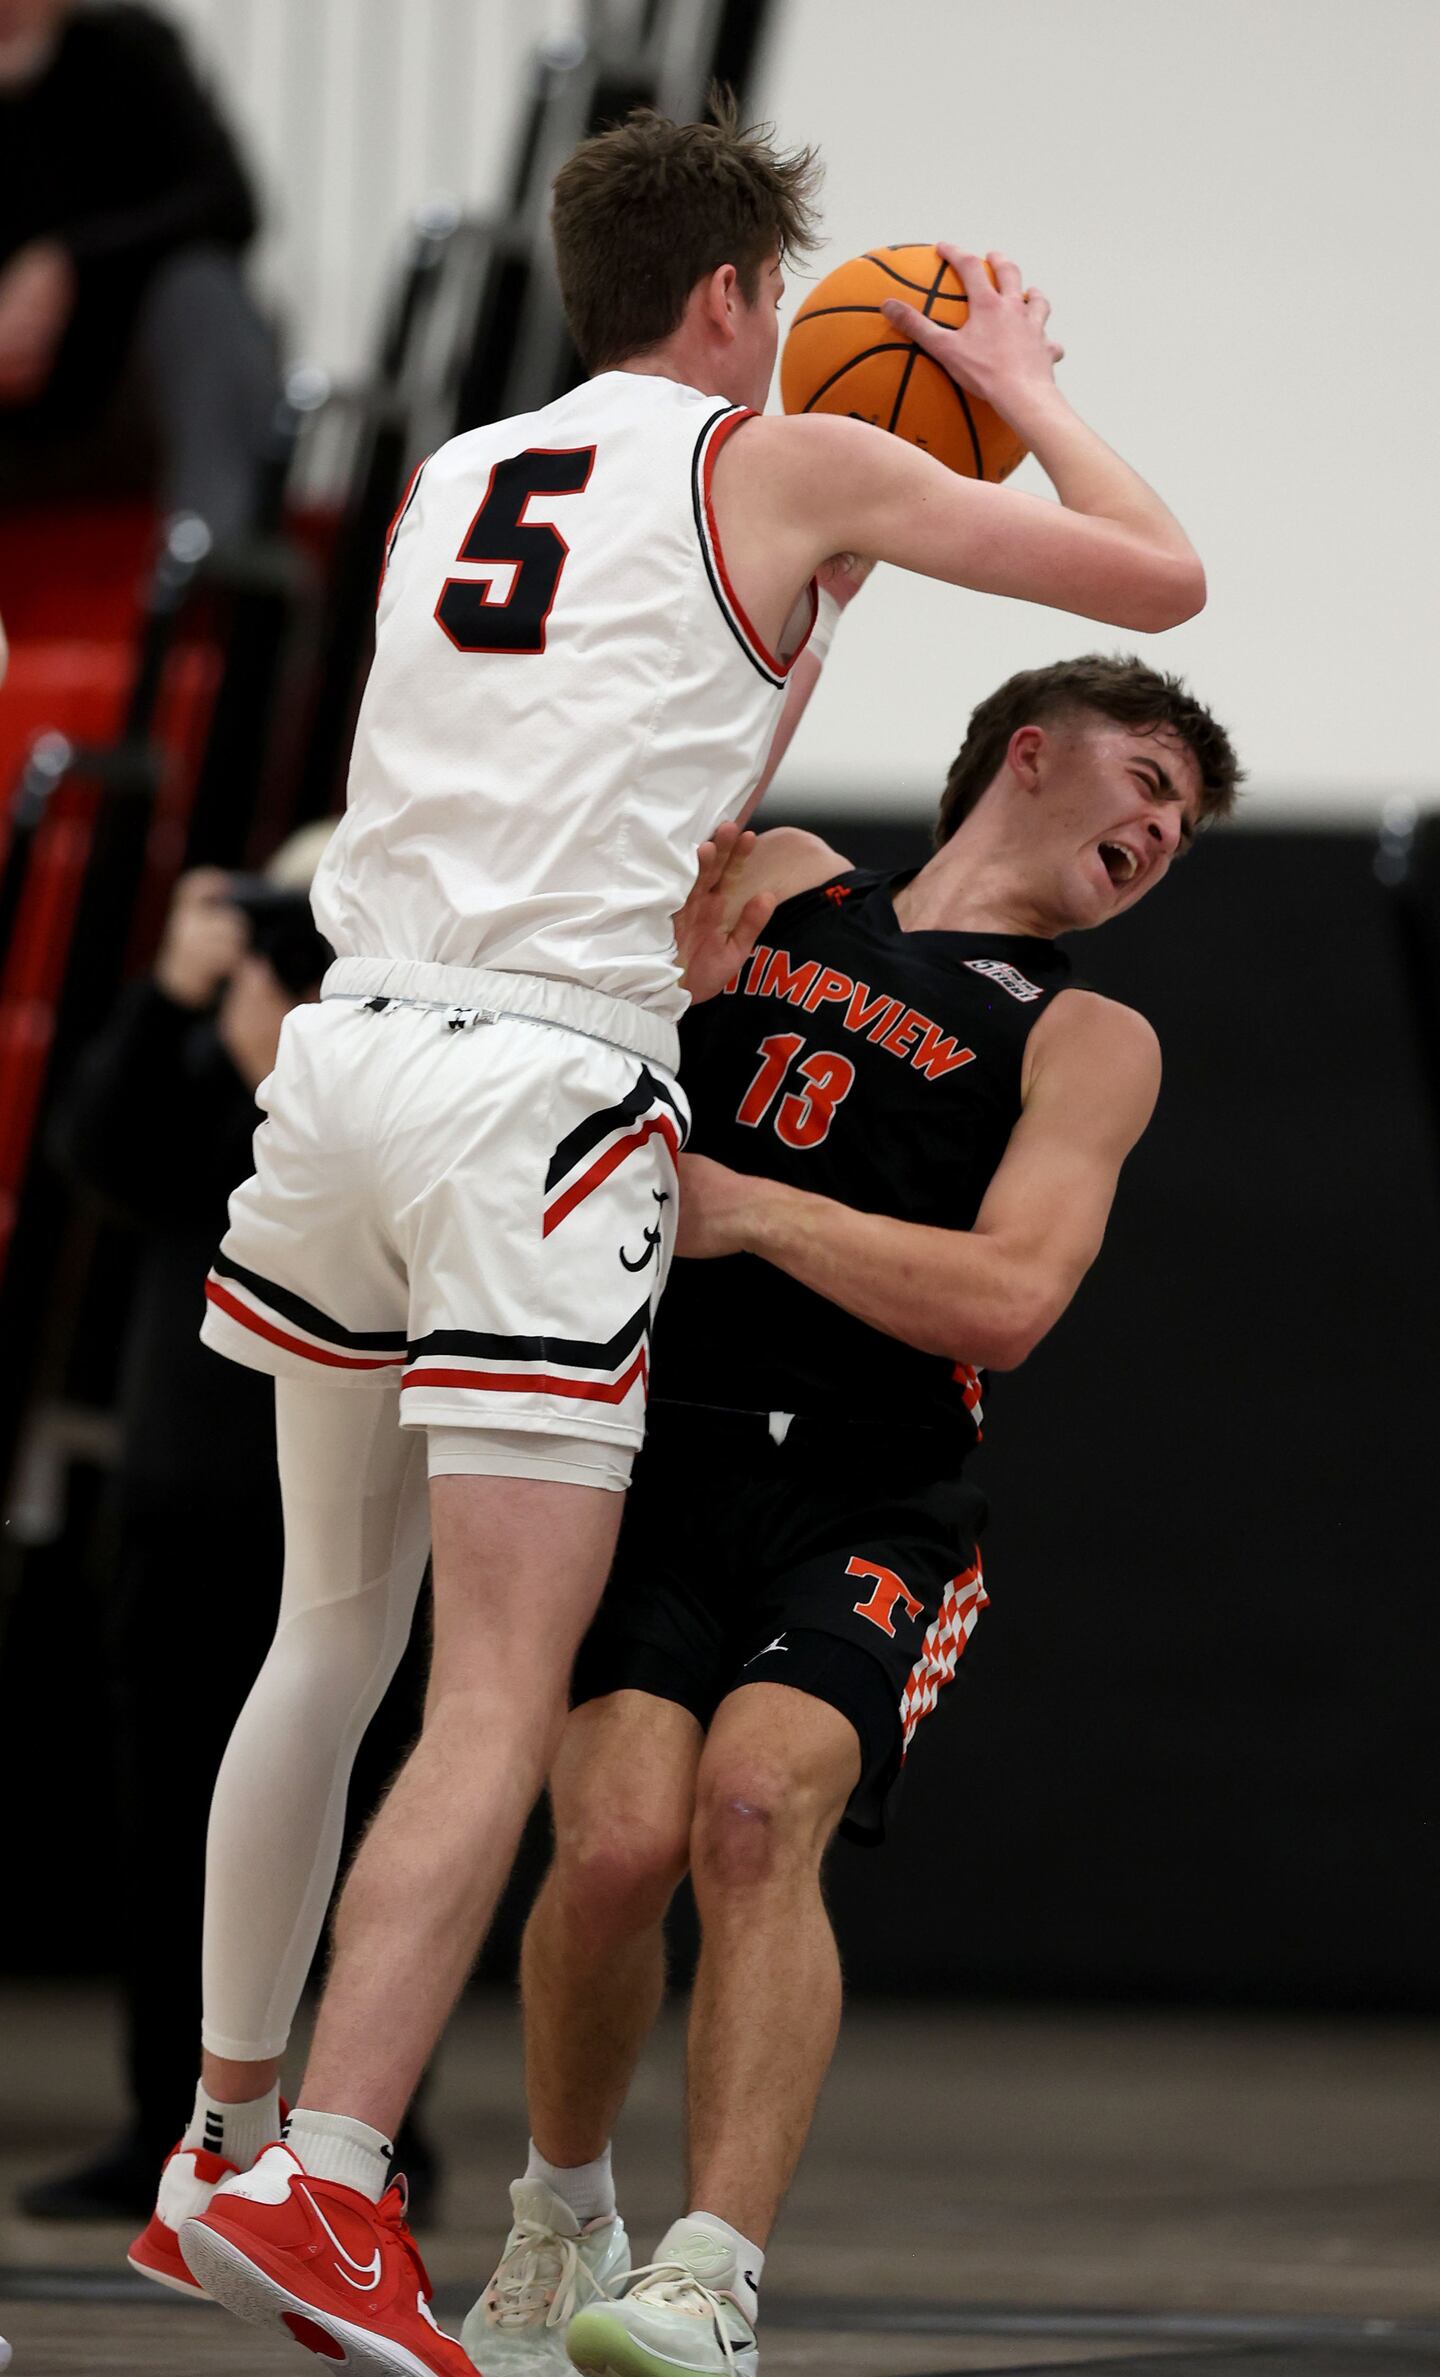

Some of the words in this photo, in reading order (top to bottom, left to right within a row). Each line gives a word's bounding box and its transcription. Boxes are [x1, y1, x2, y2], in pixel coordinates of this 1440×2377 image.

[433, 444, 597, 654] 5
[735, 1032, 856, 1150] 13
[845, 1555, 925, 1639] T
